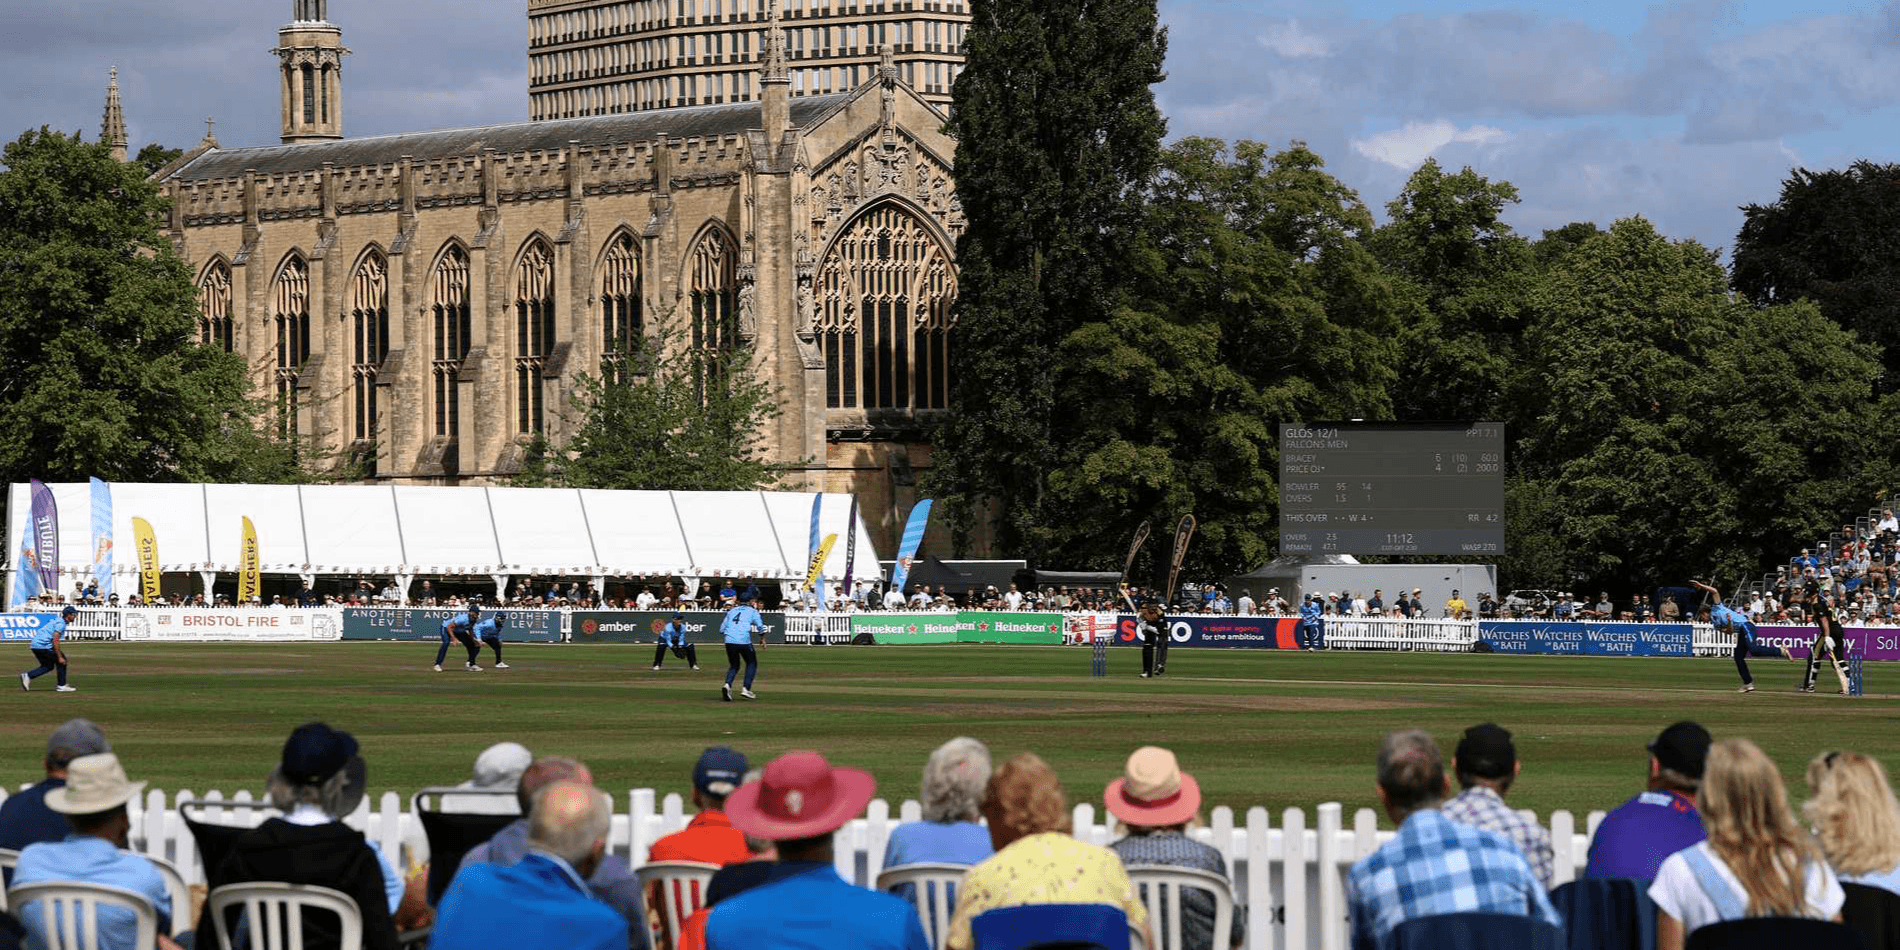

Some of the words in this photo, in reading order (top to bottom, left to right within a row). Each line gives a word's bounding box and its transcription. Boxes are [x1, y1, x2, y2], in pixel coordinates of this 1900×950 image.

[1285, 428, 1313, 438] GLOS
[1317, 428, 1338, 439] 12/1
[1484, 428, 1498, 437] 7.1
[1285, 440, 1325, 448] FALCONS
[1327, 440, 1348, 448] MEN
[1285, 454, 1316, 462] BRACEY
[1452, 453, 1468, 463] (10)
[1480, 453, 1498, 462] 60.0
[1285, 465, 1309, 473] PRICE
[1456, 464, 1468, 473] (2)
[1476, 464, 1498, 472] 200.0
[1285, 482, 1320, 490] BOWLER
[1285, 494, 1312, 502] OVERS
[1286, 514, 1304, 522] THIS
[1305, 514, 1328, 522] OVER
[1348, 514, 1358, 522] W
[1468, 514, 1480, 522] RR
[1387, 534, 1413, 544] 11:12
[1483, 543, 1496, 551] 270
[352, 610, 412, 618] ANOTHER
[732, 612, 742, 624] 4
[0, 616, 40, 628] ETRO
[183, 616, 243, 626] BRISTOL
[248, 616, 279, 627] FIRE
[599, 622, 637, 632] amber
[686, 622, 706, 632] ber
[854, 624, 905, 634] Heineken
[924, 621, 976, 634] Heineken
[995, 622, 1046, 632] Heineken
[1480, 626, 1530, 640] WATCHES
[1532, 626, 1582, 641] WATCHES
[1586, 627, 1637, 642] WATCHES
[1640, 628, 1690, 643] WATCHES
[1500, 642, 1527, 650] BATH
[1553, 642, 1579, 650] BATH
[1607, 643, 1633, 651] BATH
[1660, 644, 1686, 652] BATH
